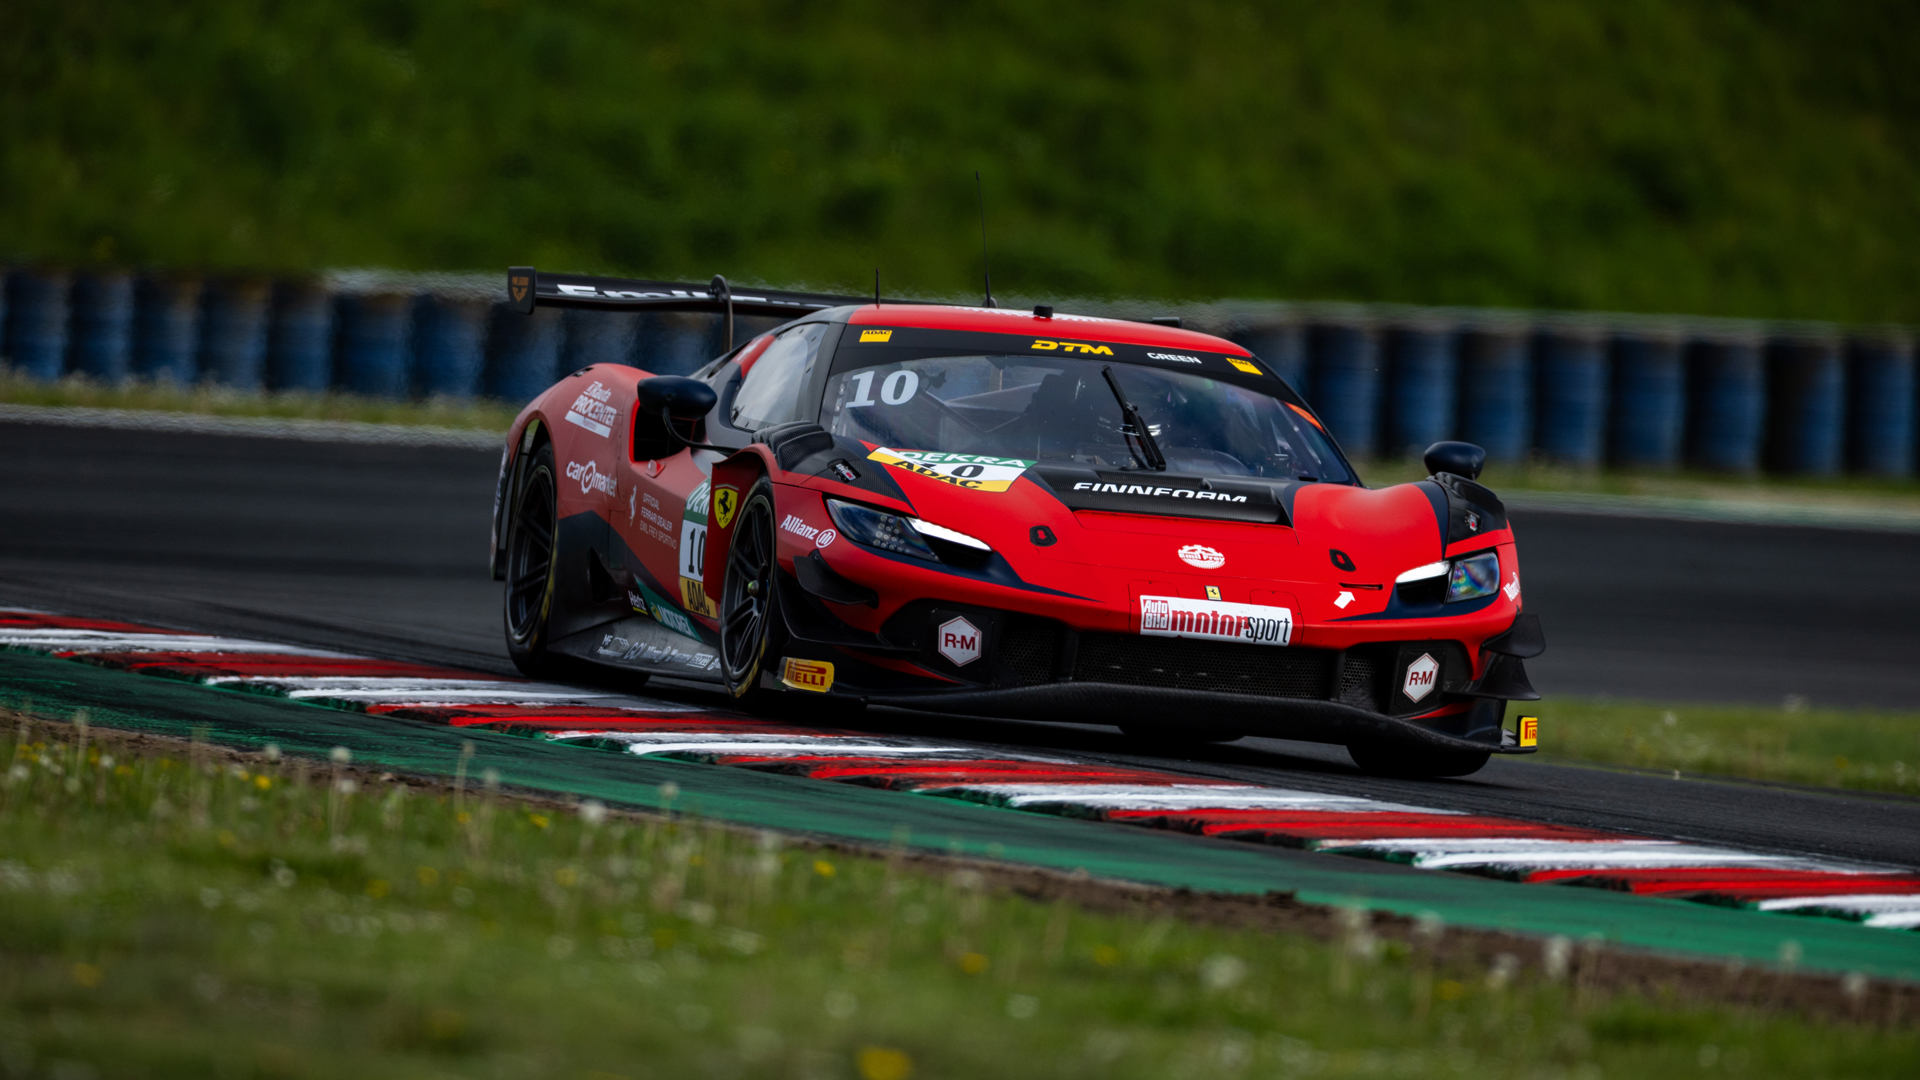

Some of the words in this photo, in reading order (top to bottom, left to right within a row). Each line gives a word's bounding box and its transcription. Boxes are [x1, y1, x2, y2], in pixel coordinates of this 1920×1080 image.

[1031, 340, 1114, 355] DTM
[1146, 352, 1202, 364] GREEN
[845, 370, 919, 408] 10
[571, 394, 617, 426] PROCENTER
[898, 451, 1027, 467] DEKRA
[893, 461, 983, 489] ADAC
[643, 493, 660, 510] OFFICIAL
[780, 514, 819, 540] Allianz
[688, 528, 707, 576] 10
[627, 590, 647, 611] Hertz
[687, 580, 710, 615] ADAC
[1144, 600, 1168, 613] Auto
[1144, 613, 1168, 629] Bild
[944, 633, 976, 651] R-M
[1408, 671, 1434, 686] R-M
